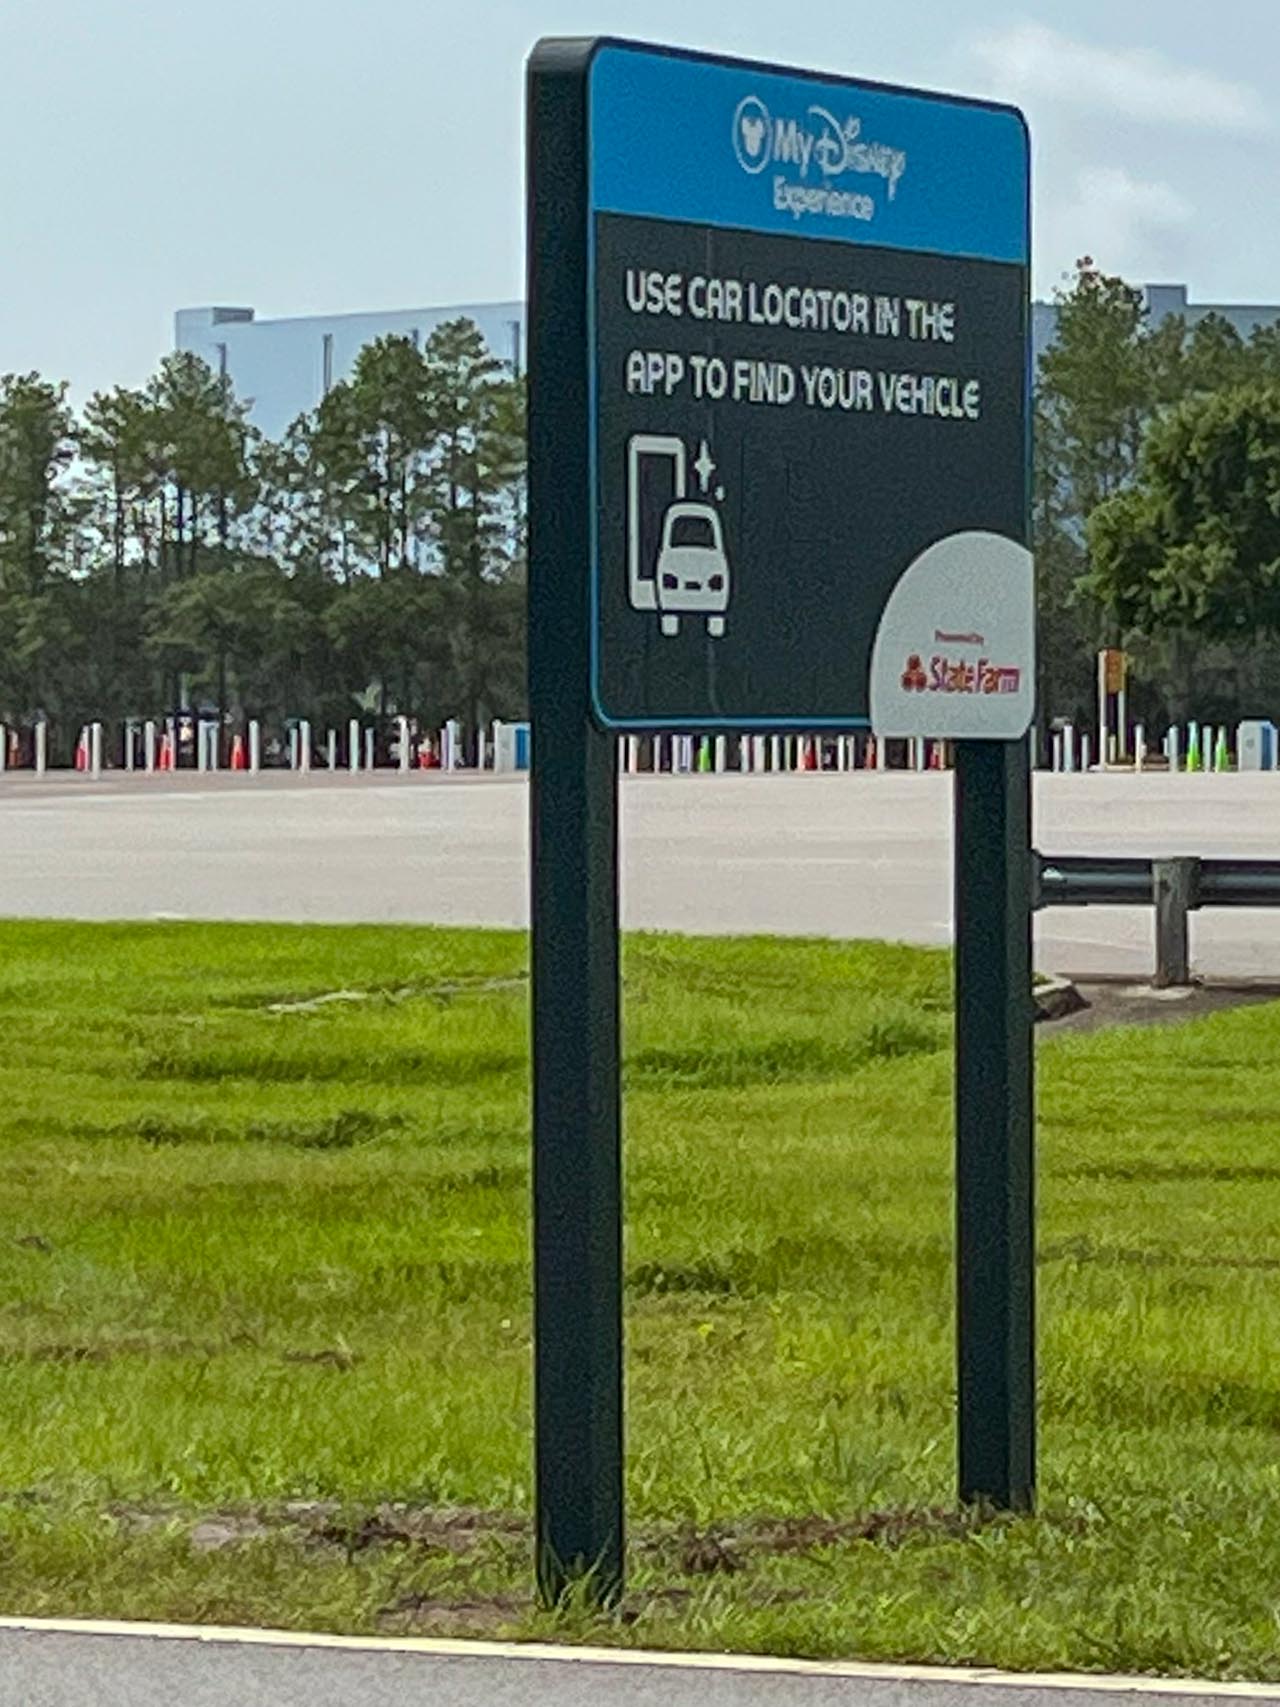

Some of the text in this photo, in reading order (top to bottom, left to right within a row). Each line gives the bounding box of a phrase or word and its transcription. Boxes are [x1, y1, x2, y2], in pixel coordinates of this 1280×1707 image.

[773, 105, 906, 201] My Disney
[773, 176, 874, 221] Experience
[627, 270, 955, 343] USE CAR LOCATOR IN THE
[626, 350, 981, 420] APP TO FIND YOUR VEHICLE
